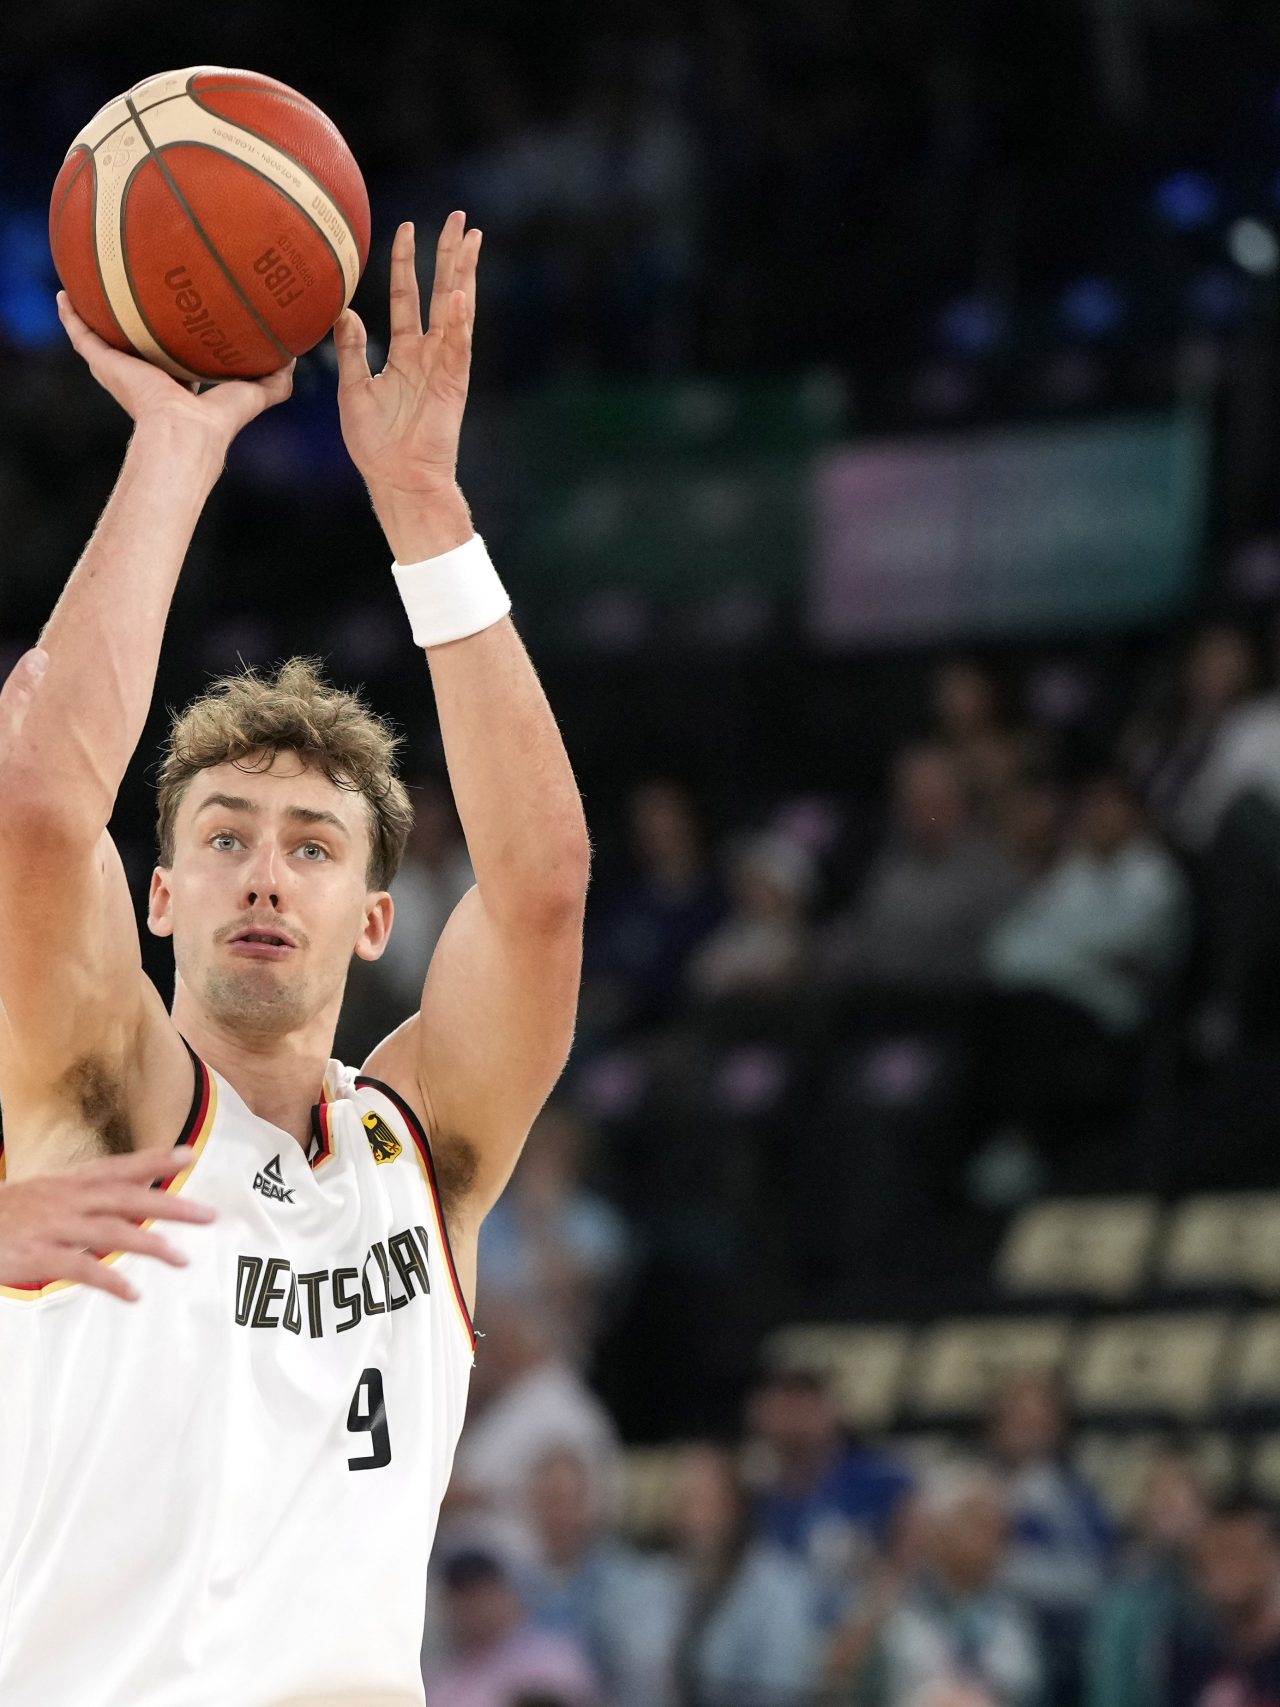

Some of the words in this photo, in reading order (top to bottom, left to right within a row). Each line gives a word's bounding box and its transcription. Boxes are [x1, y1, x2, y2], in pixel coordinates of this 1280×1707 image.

[254, 247, 304, 309] FIBA
[278, 236, 314, 287] APPROVED
[165, 264, 249, 366] molten
[253, 1170, 296, 1204] PEAK
[346, 1367, 392, 1472] 9
